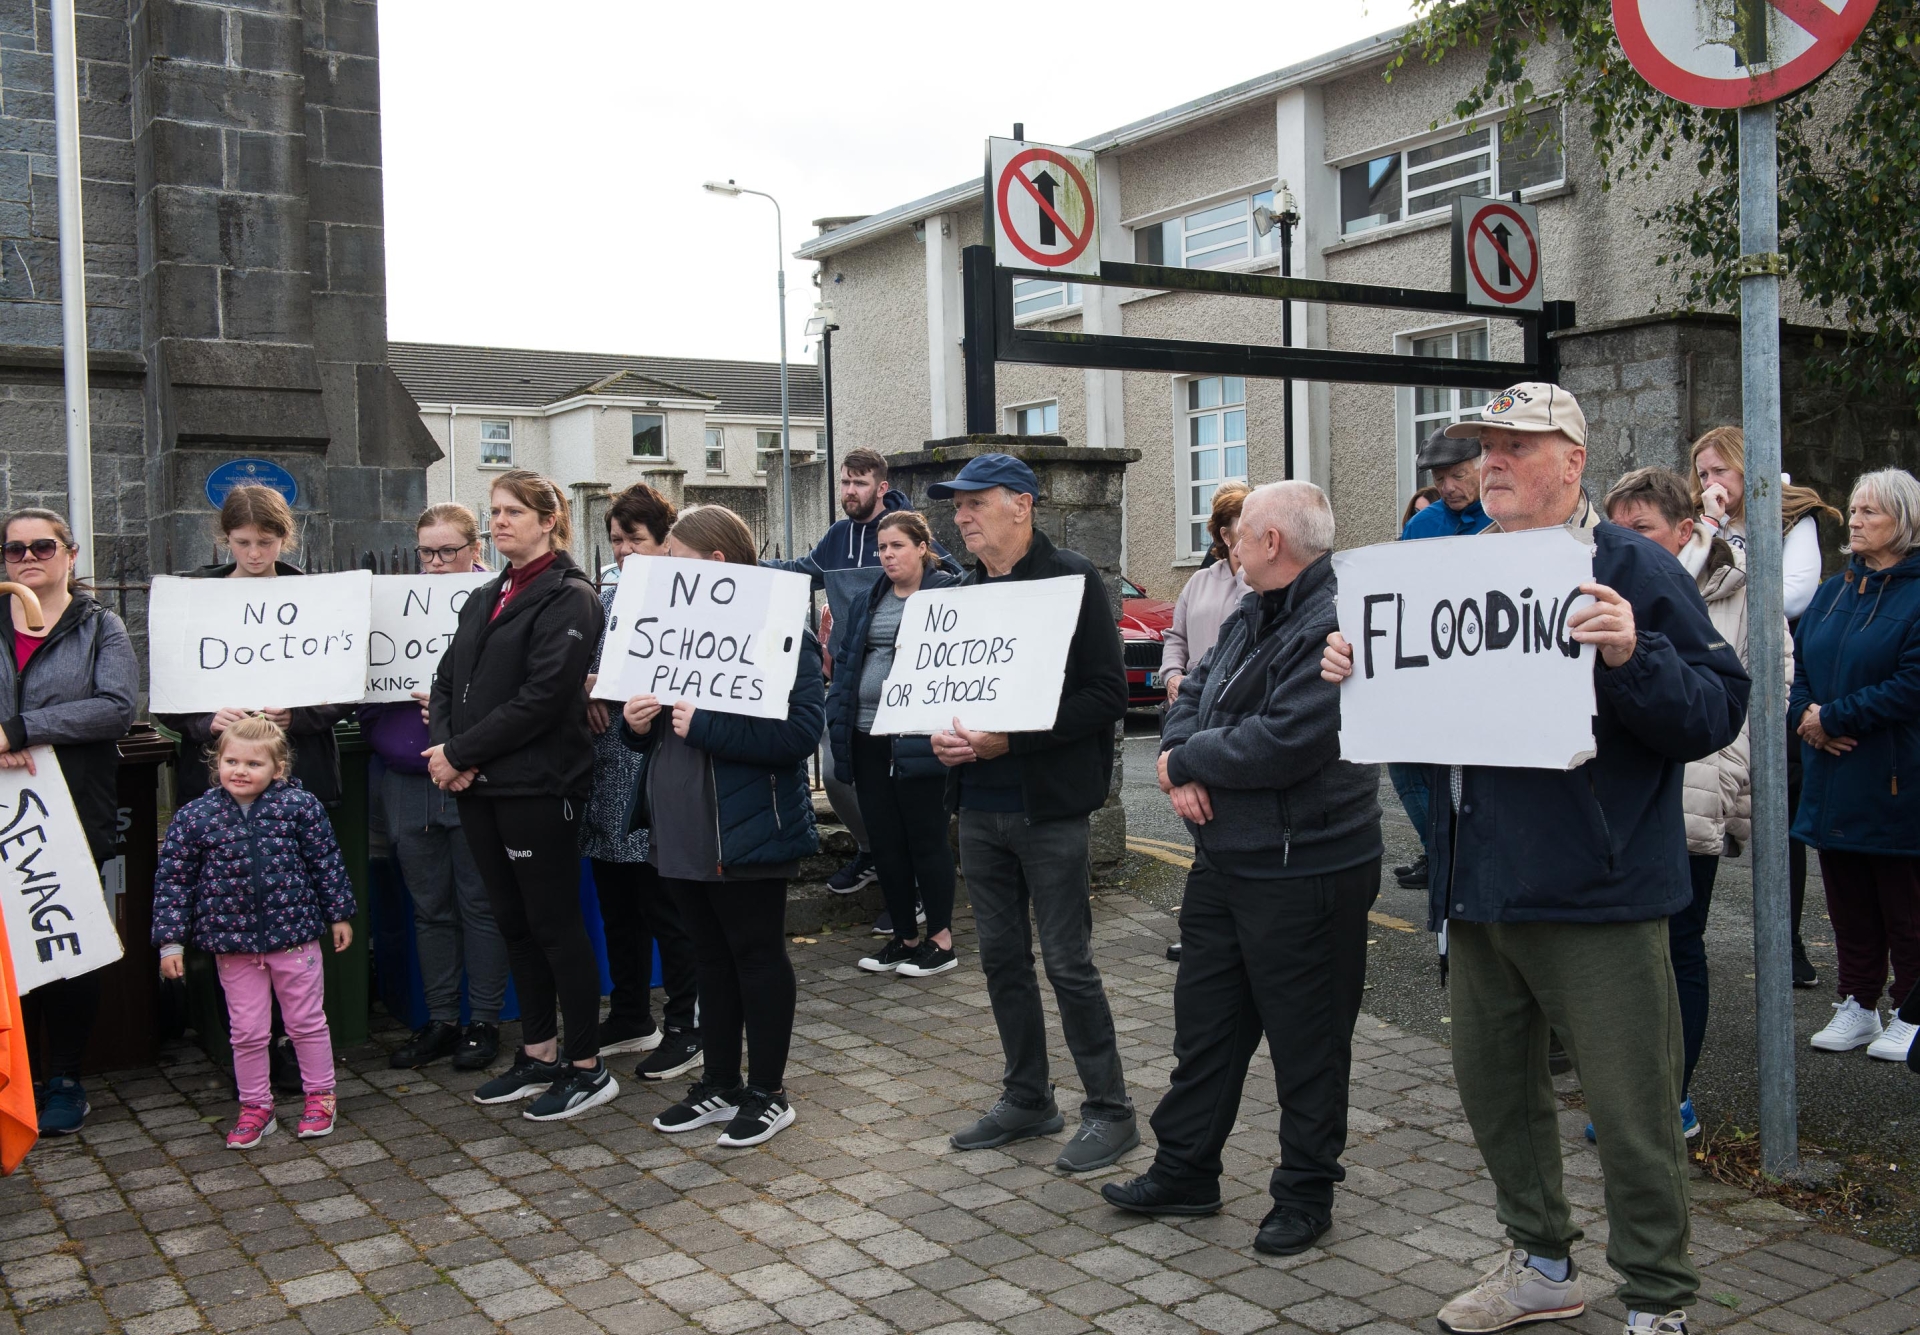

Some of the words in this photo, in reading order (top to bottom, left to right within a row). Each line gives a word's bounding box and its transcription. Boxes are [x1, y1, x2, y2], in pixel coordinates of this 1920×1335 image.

[403, 587, 471, 616] NO
[670, 571, 736, 608] NO
[244, 602, 298, 625] NO
[924, 604, 958, 632] NO
[628, 617, 754, 665] SCHOOL
[915, 636, 1018, 670] DOCTORS
[366, 676, 420, 692] KING
[650, 665, 764, 701] PLACES
[886, 683, 913, 708] OR
[0, 788, 82, 963] SEWAGE
